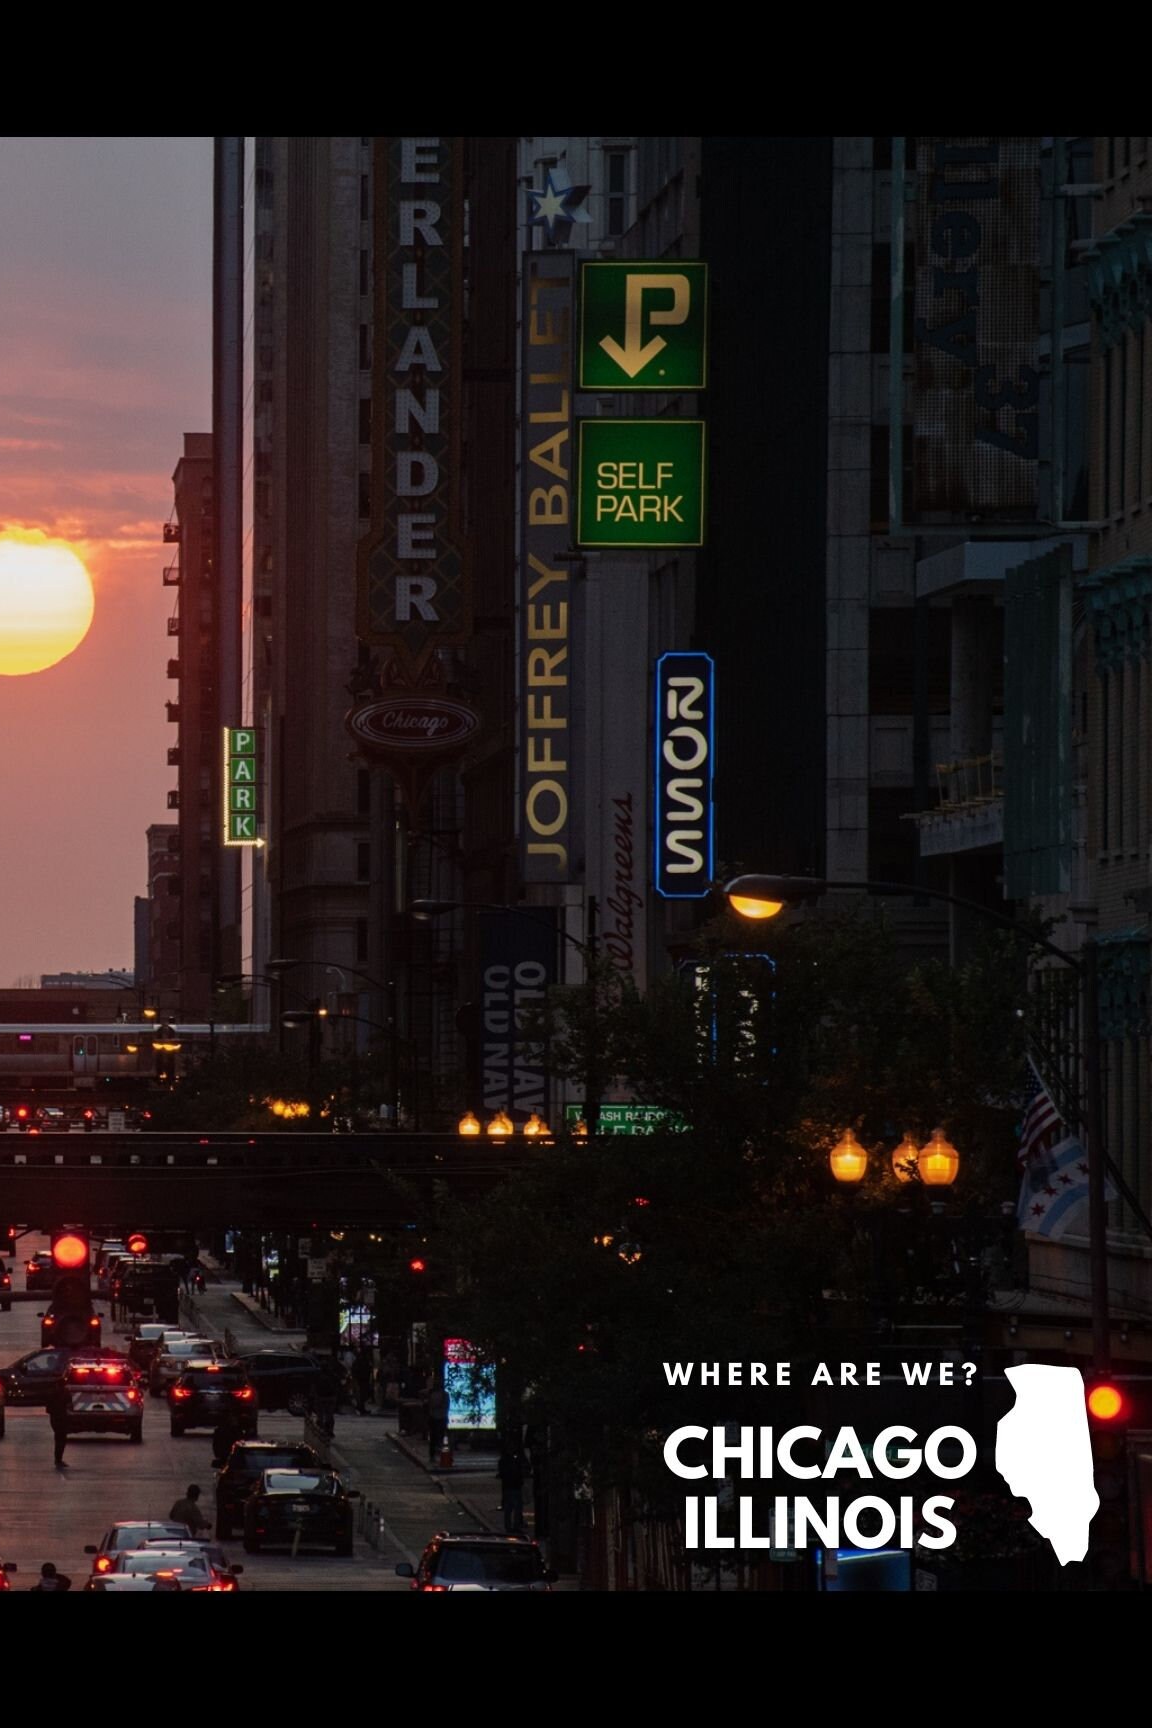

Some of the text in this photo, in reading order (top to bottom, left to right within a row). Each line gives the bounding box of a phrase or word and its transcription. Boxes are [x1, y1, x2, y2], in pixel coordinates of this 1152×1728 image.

[396, 137, 443, 621] ERLANDER
[975, 366, 1040, 460] 37
[596, 495, 684, 523] PARK
[597, 462, 674, 490] SELF
[525, 262, 571, 872] JOFFREY BALLET
[382, 711, 449, 737] Chicago
[662, 676, 709, 875] ROSS
[234, 732, 252, 836] PARK
[603, 791, 644, 971] Walgreens
[483, 965, 510, 1112] OLD NAV
[513, 1041, 546, 1115] NAV
